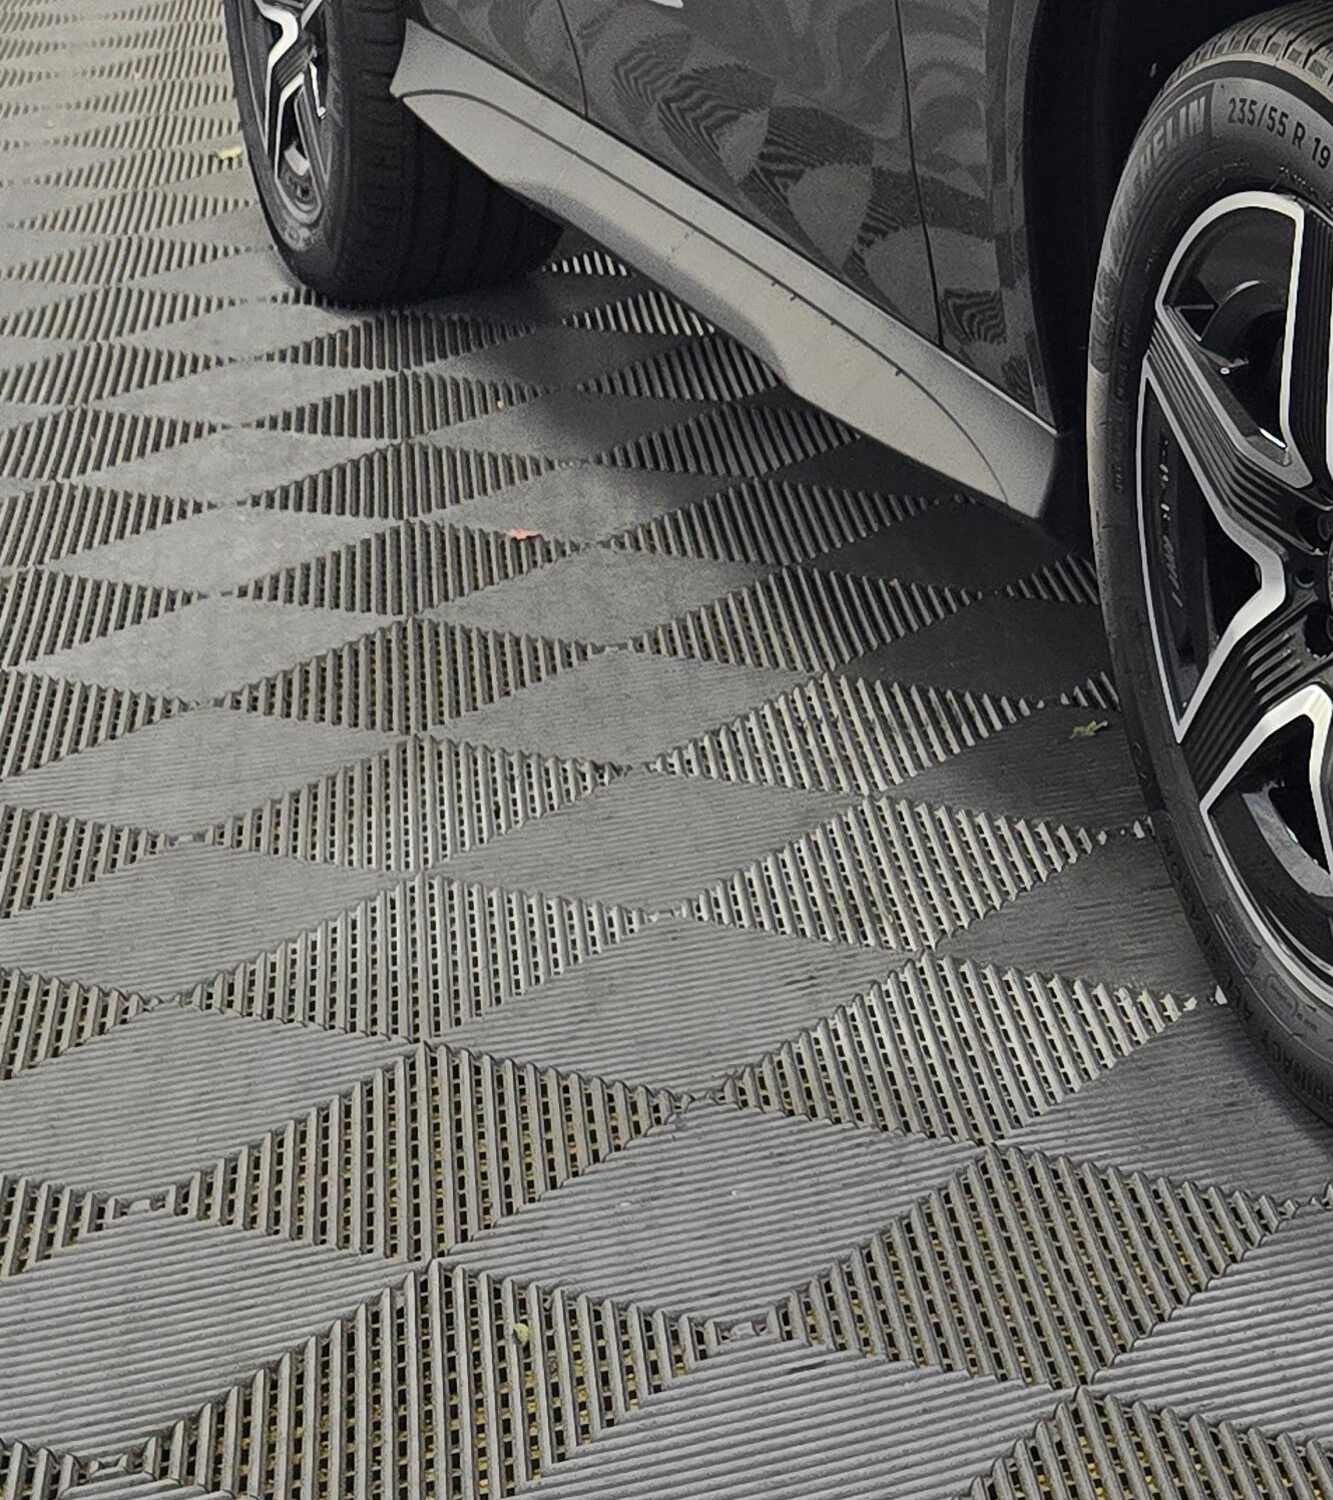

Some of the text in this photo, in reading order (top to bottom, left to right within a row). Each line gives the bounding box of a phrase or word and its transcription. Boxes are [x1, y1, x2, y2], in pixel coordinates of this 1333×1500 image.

[1226, 96, 1332, 170] 235/55 R 19
